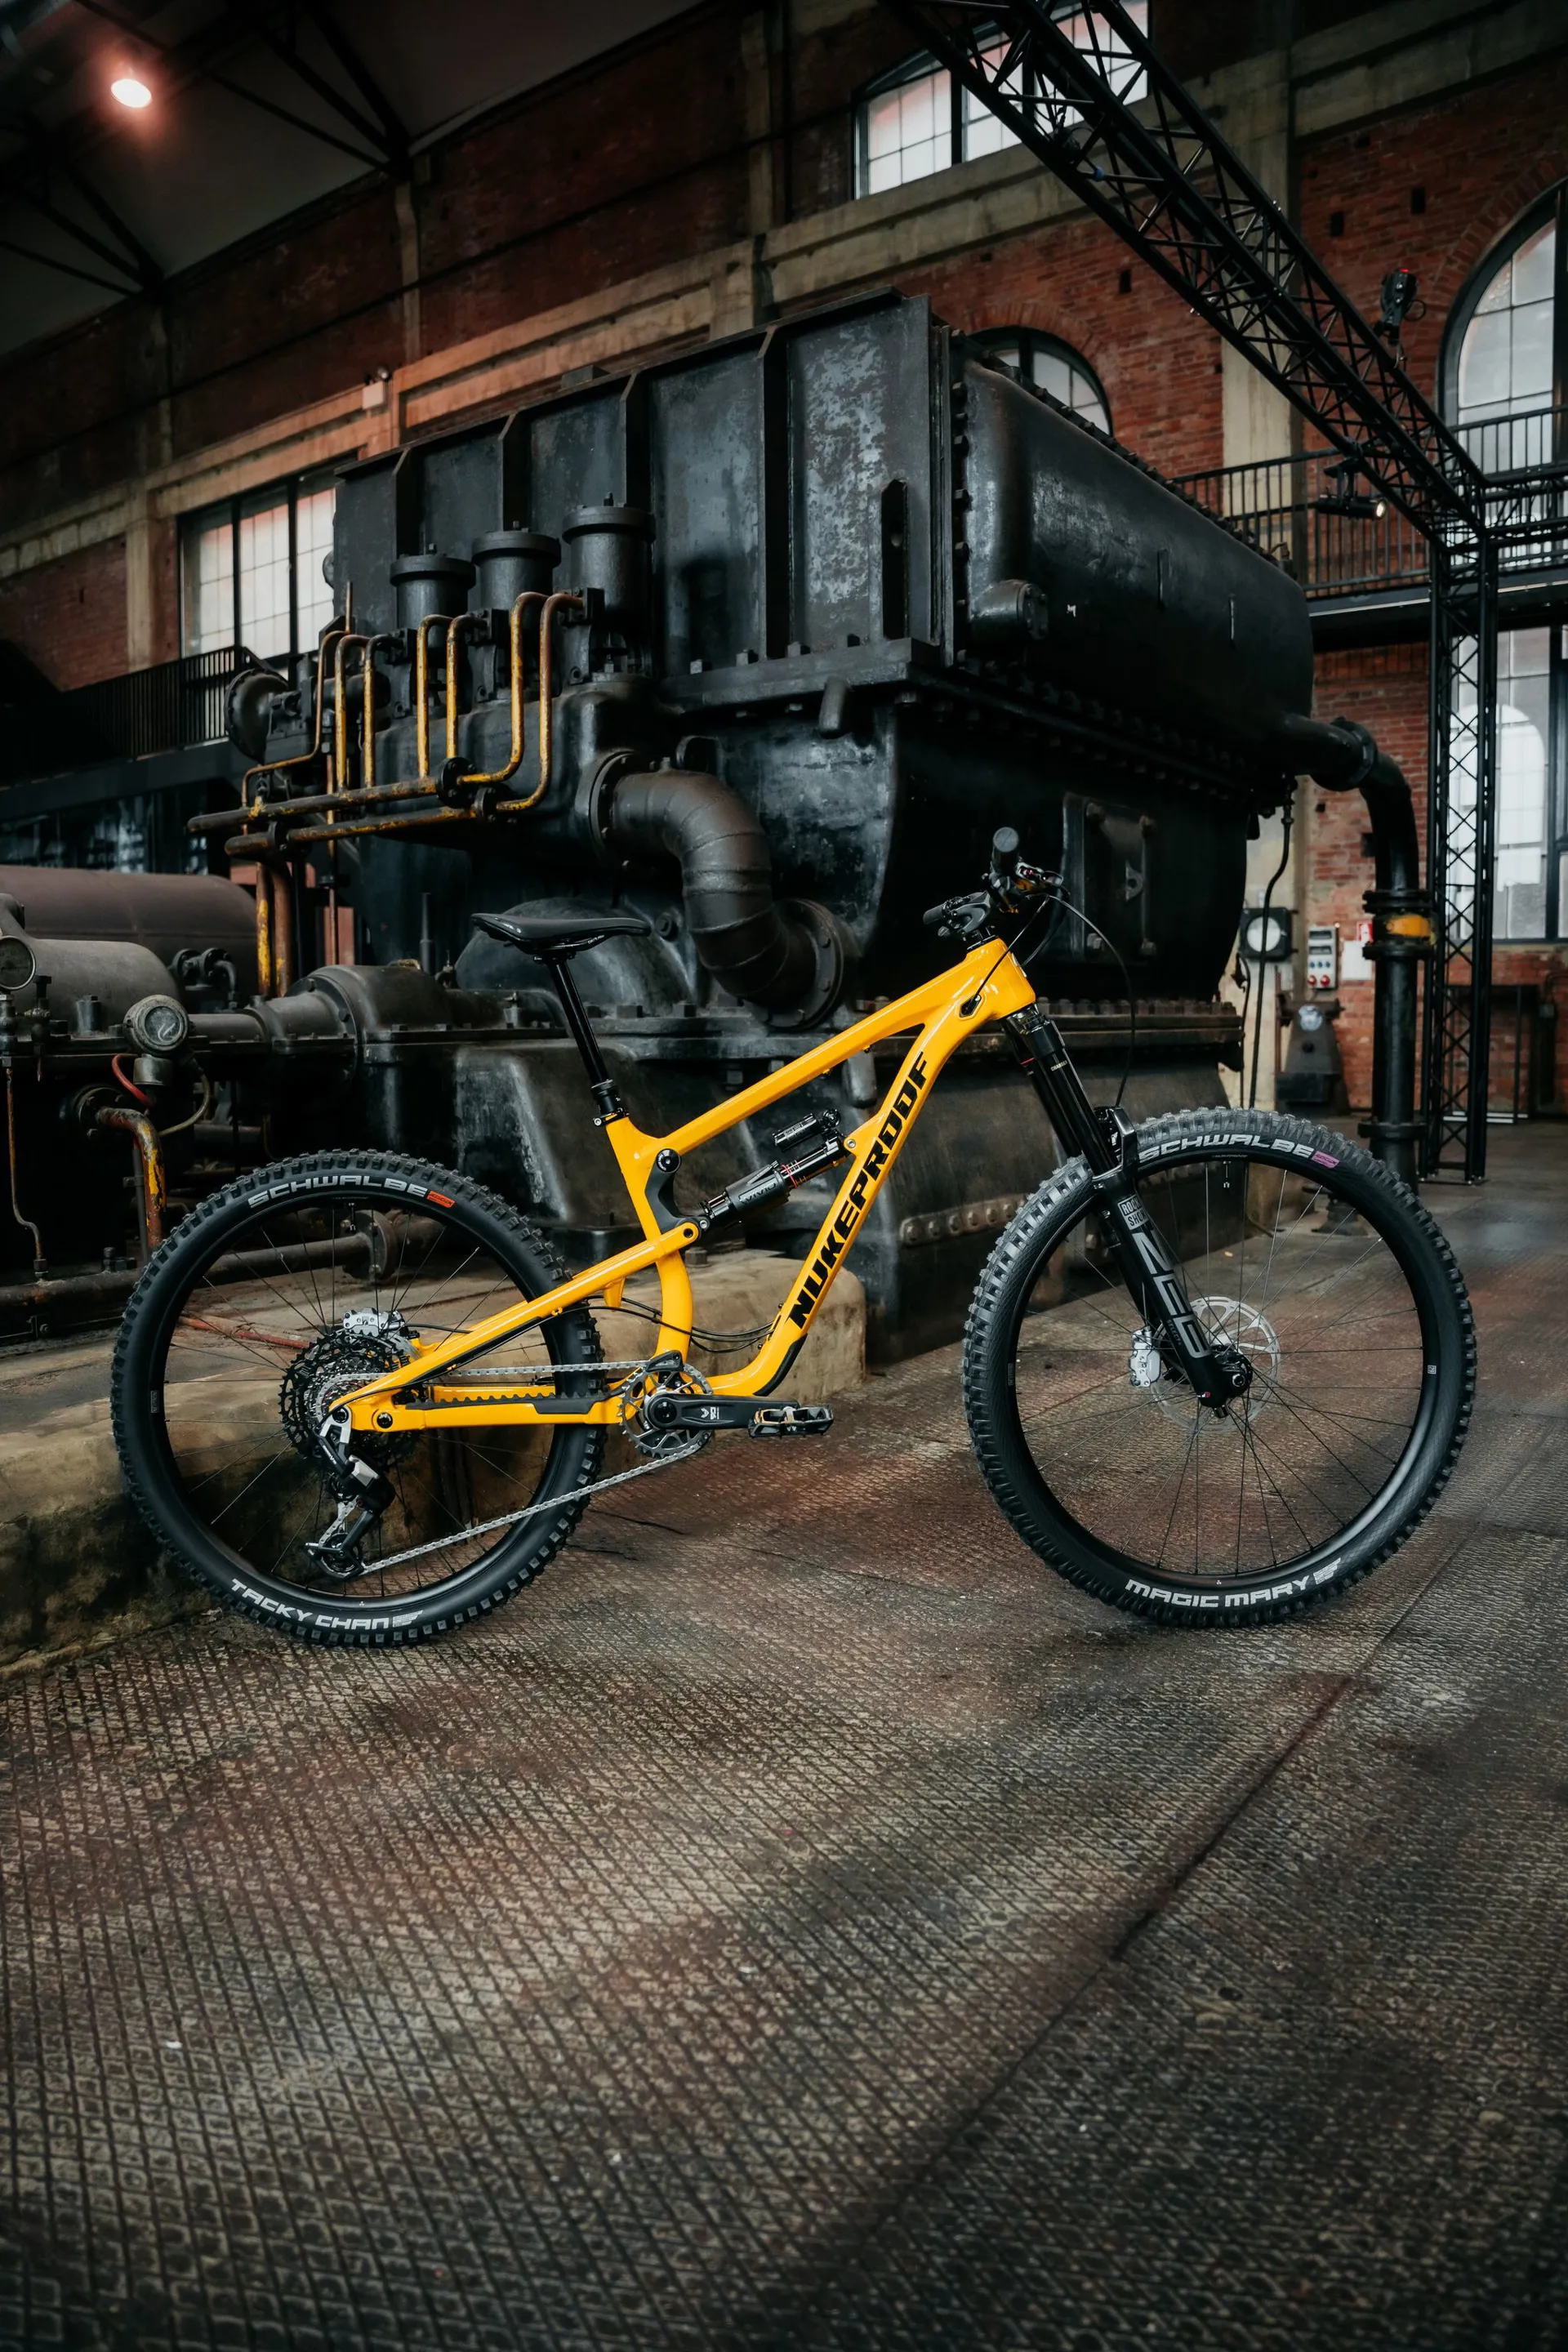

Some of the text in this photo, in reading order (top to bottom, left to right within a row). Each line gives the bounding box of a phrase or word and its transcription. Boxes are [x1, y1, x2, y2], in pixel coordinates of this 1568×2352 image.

[1138, 1134, 1315, 1164] SCHWALBE
[247, 1174, 428, 1209] SCHWALBE
[786, 1051, 928, 1329] NUKEPROOF
[1120, 1196, 1141, 1215] ROCK
[231, 1578, 314, 1622] TACKY
[314, 1614, 390, 1630] CHAN
[1124, 1575, 1310, 1608] MAGIC MARY
